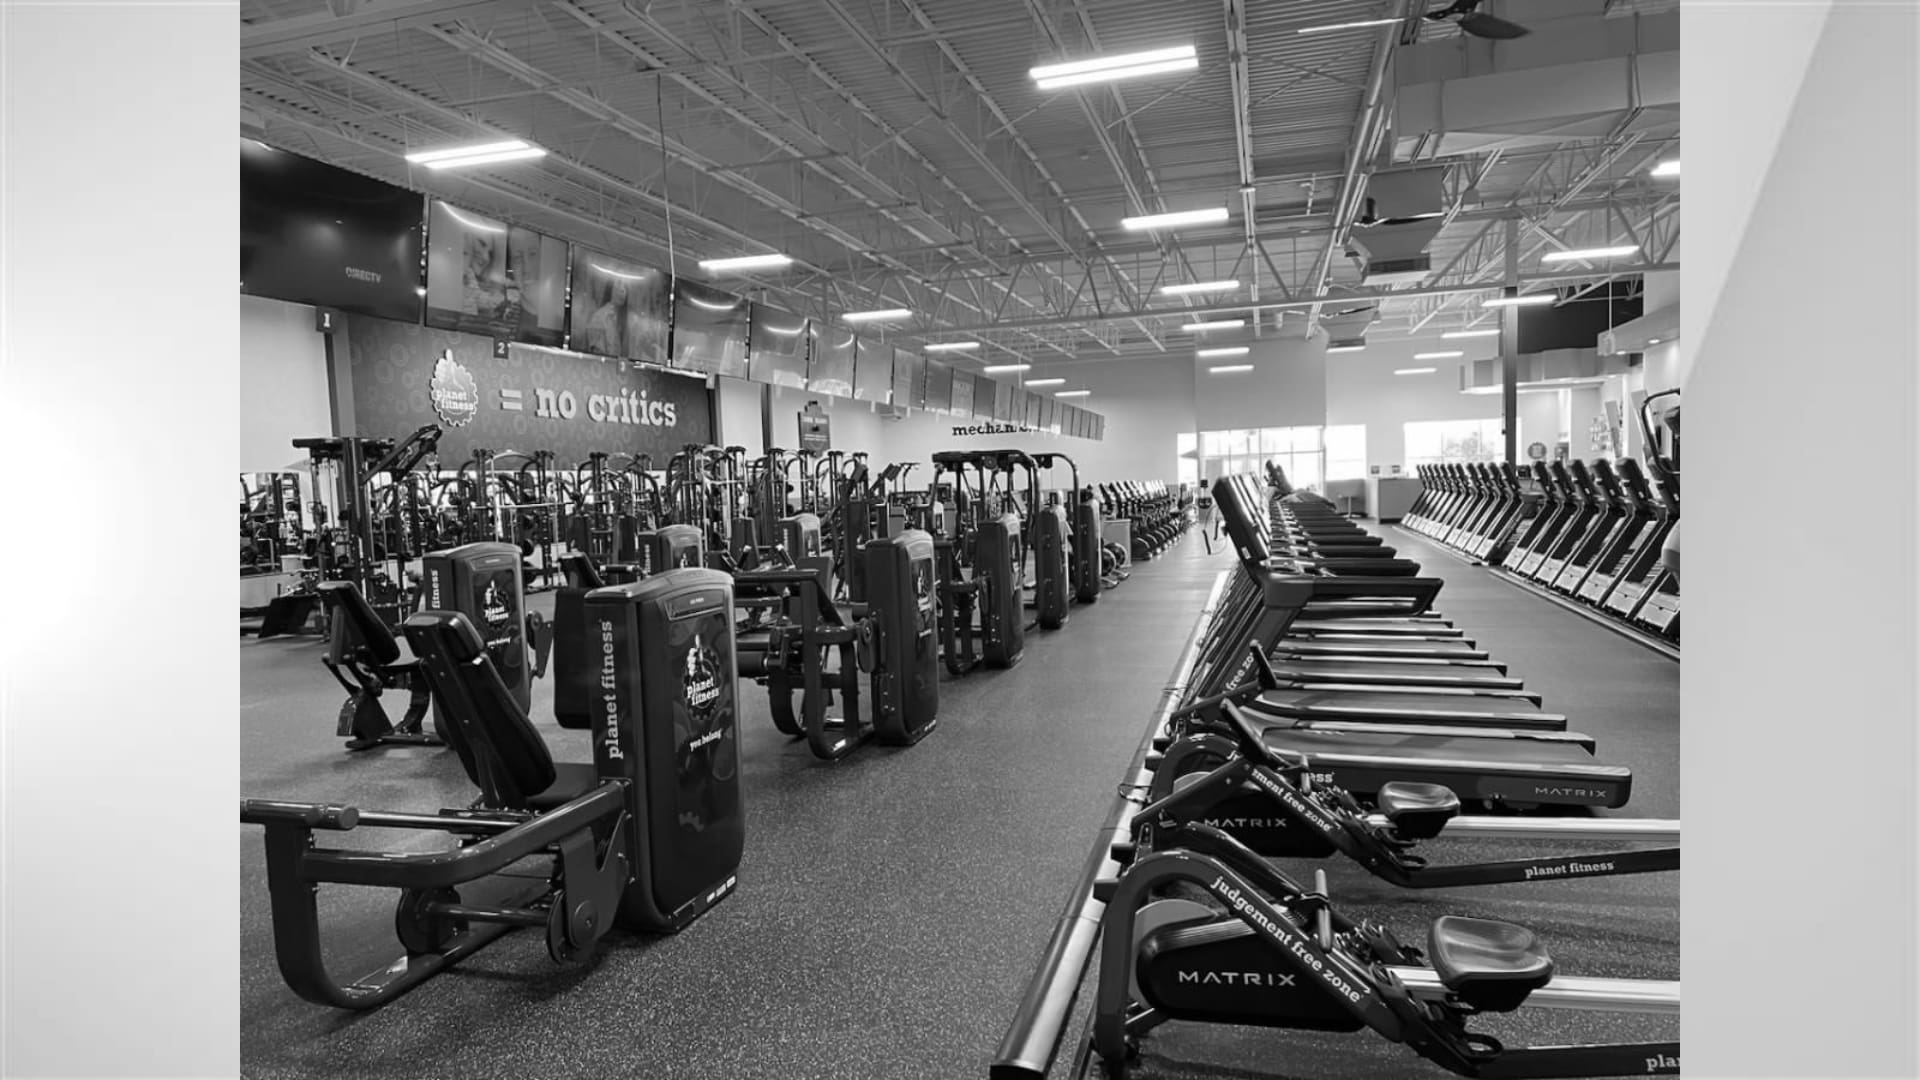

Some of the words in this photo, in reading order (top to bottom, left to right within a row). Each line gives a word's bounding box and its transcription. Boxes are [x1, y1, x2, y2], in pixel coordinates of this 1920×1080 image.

[345, 266, 382, 284] DIRECTV
[323, 312, 331, 328] 1
[498, 342, 505, 354] 2
[436, 388, 467, 401] planet
[535, 387, 577, 419] no
[588, 387, 677, 428] critics
[429, 569, 440, 609] fitness
[601, 620, 616, 689] fitness
[687, 676, 714, 699] planet
[691, 687, 720, 706] fitness
[604, 694, 624, 760] planet
[690, 738, 702, 752] you
[701, 727, 722, 745] belong
[1535, 786, 1608, 798] MATRIX
[1282, 792, 1305, 812] free
[1304, 810, 1331, 832] zone
[1204, 817, 1287, 828] MATRIX
[1524, 864, 1567, 879] planet
[1569, 861, 1615, 873] fitness
[1210, 875, 1293, 945] judgement
[1291, 940, 1323, 971] free
[1322, 968, 1362, 1002] zone
[1178, 970, 1296, 986] MATRIX
